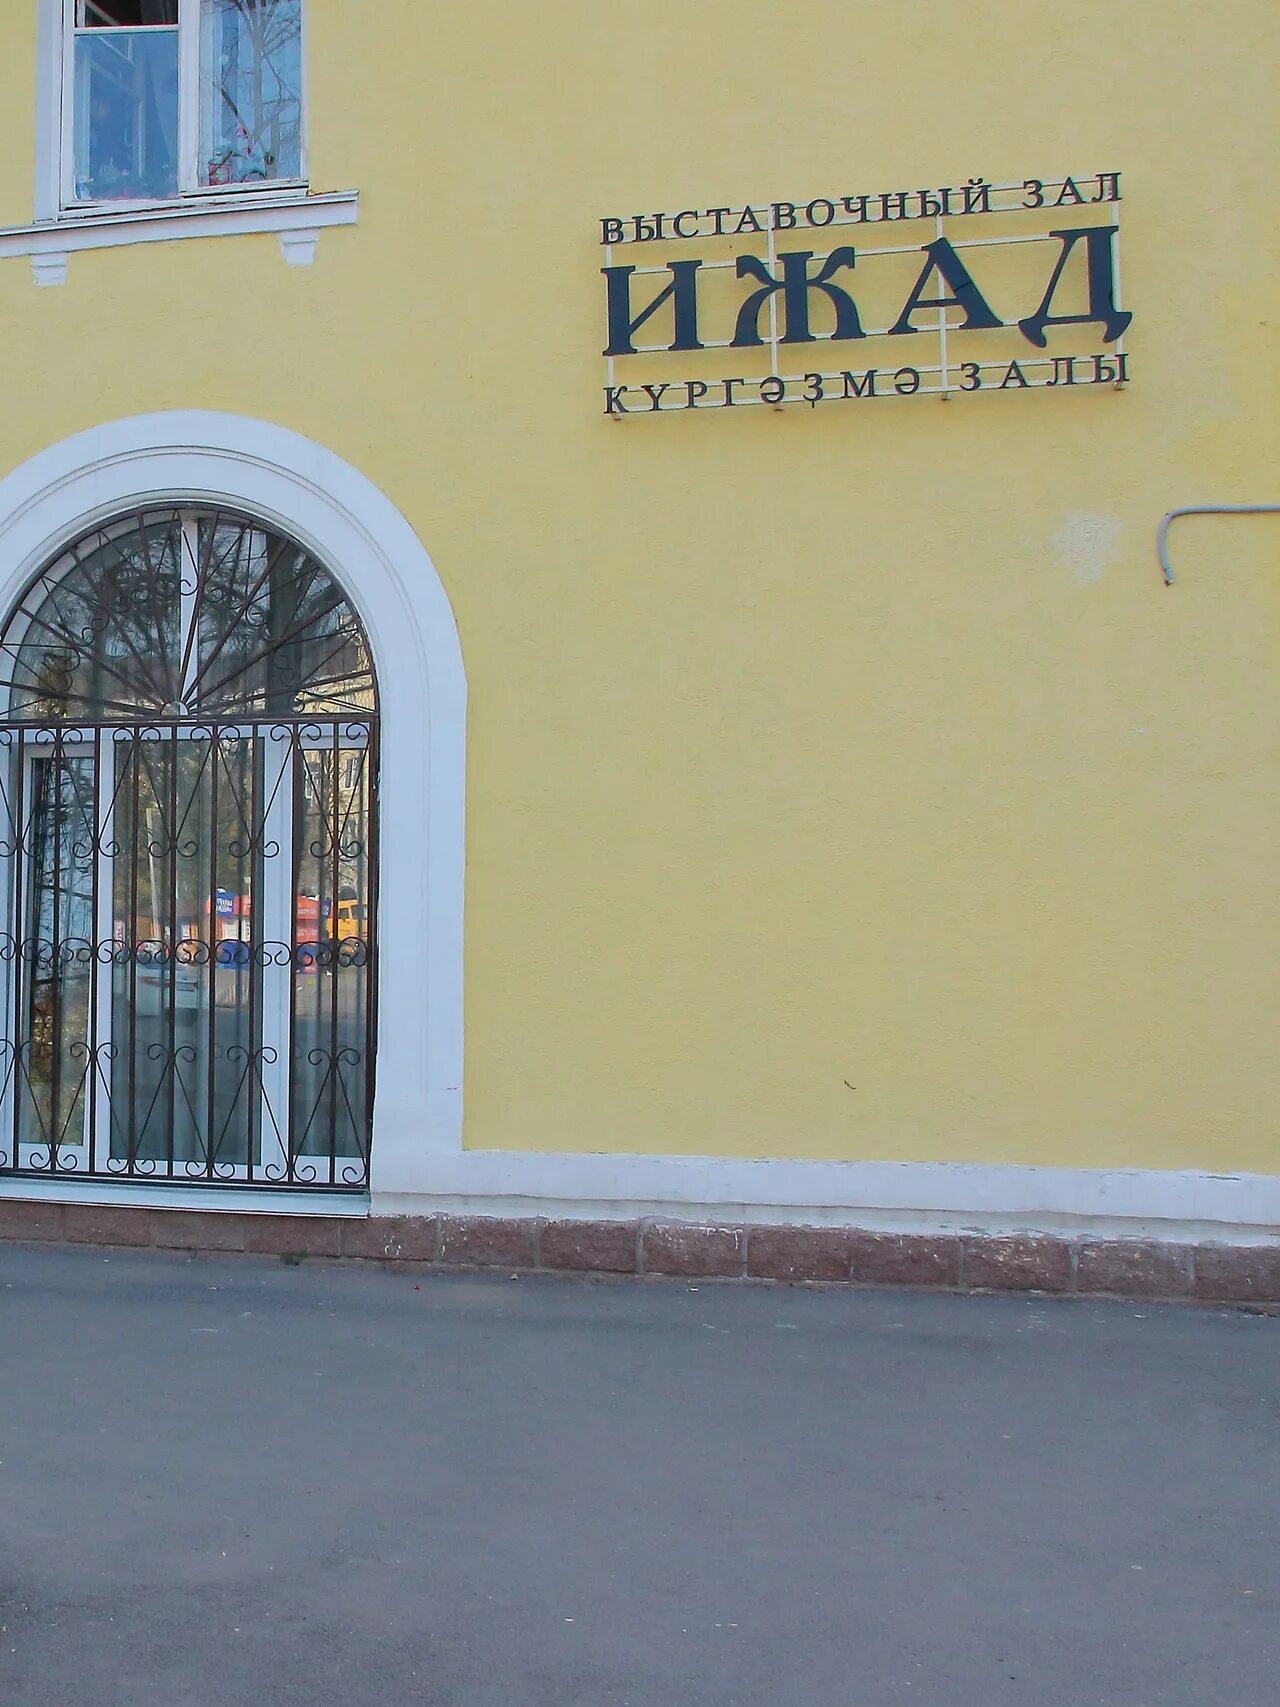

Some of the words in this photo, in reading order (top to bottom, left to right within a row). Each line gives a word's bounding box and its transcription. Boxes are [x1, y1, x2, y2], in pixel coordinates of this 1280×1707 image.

[600, 178, 993, 245] ВЫСТАВОЧНЫЙ
[1022, 172, 1123, 209] ЗАЛ
[601, 225, 1132, 356] ИЖАД
[959, 353, 1130, 392] ЗАЛЫ
